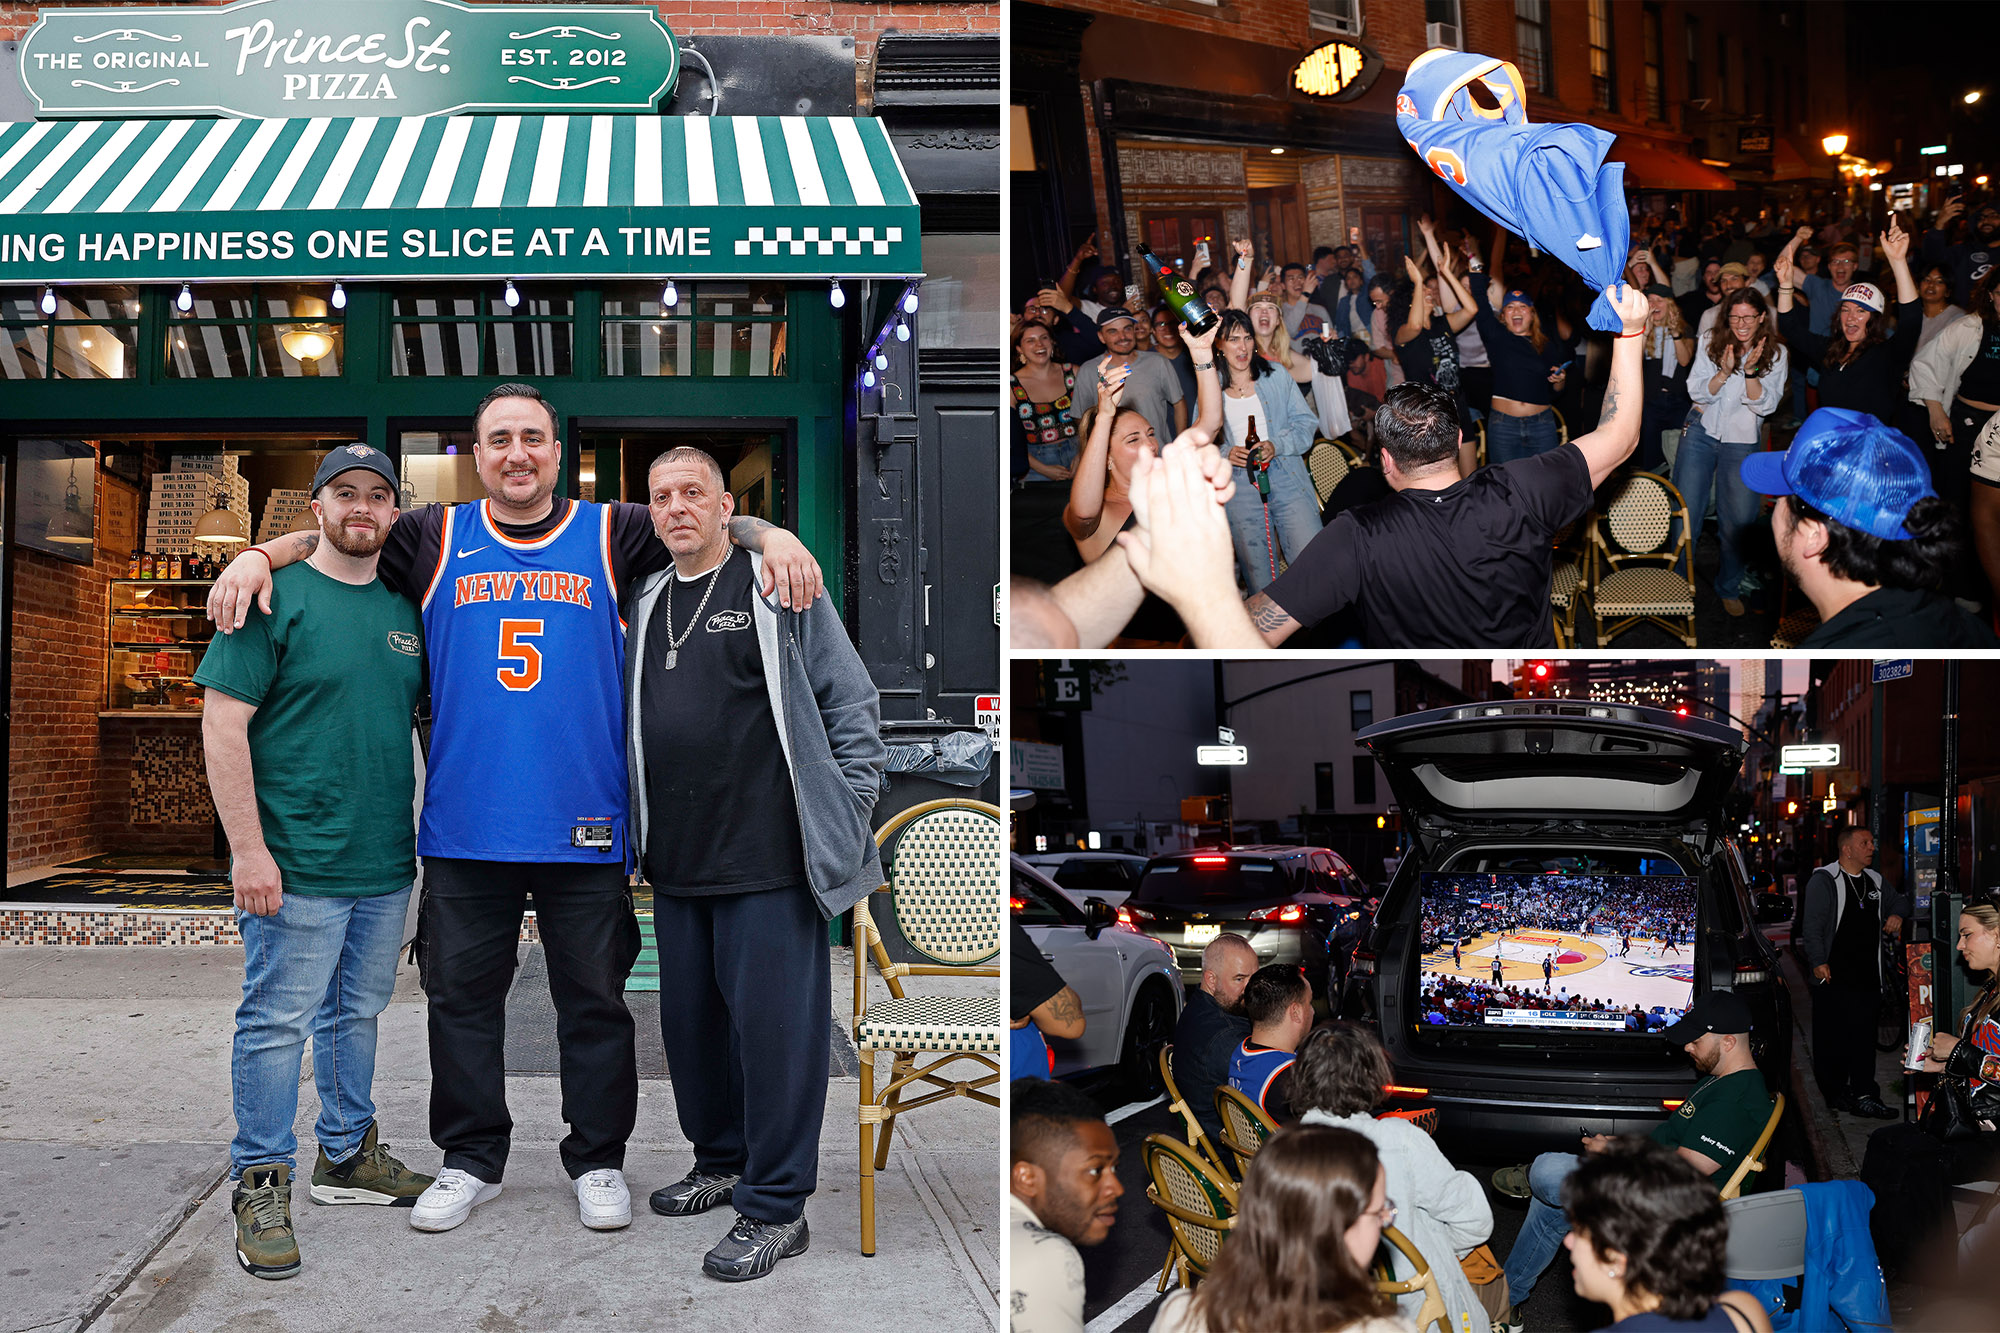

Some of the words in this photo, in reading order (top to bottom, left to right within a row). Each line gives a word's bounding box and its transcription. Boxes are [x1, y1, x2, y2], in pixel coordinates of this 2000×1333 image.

[225, 18, 387, 76] Prince
[385, 16, 452, 75] St.
[501, 49, 558, 66] EST.
[568, 49, 627, 66] 2012
[33, 53, 83, 69] THE
[92, 51, 209, 70] ORIGINAL
[282, 73, 398, 101] PIZZA
[1, 233, 66, 262] ING
[78, 230, 295, 262] HAPPINESS
[307, 228, 389, 260] ONE
[401, 227, 515, 259] SLICE
[524, 227, 575, 257] AT
[581, 227, 610, 257] A
[618, 226, 712, 257] TIME
[454, 571, 519, 609] NEW
[519, 570, 592, 610] YORK
[496, 618, 545, 692] 5
[1879, 664, 1902, 680] 302382
[990, 698, 1000, 710] W
